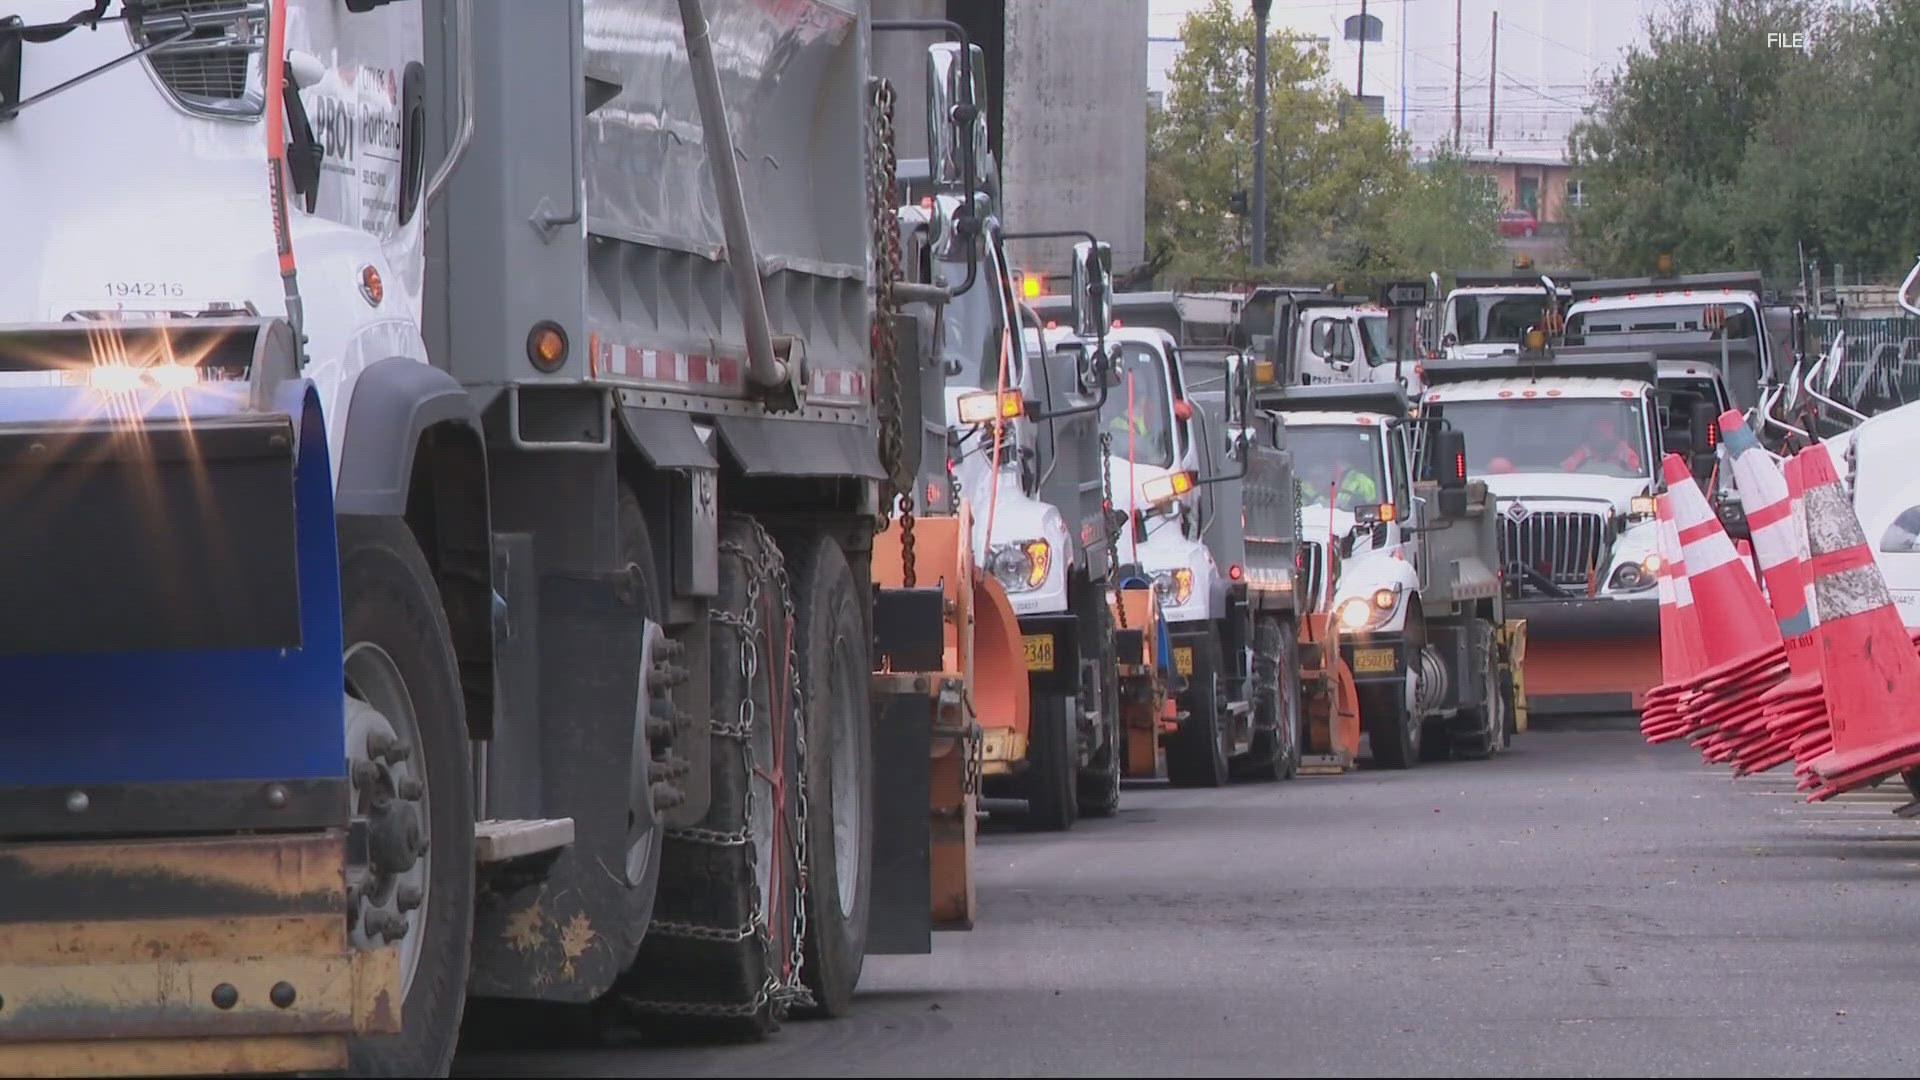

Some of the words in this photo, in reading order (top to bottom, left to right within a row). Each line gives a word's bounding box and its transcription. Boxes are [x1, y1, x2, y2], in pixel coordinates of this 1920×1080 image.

[316, 94, 354, 162] PBOT
[362, 103, 400, 151] Portland
[104, 282, 184, 297] 194216
